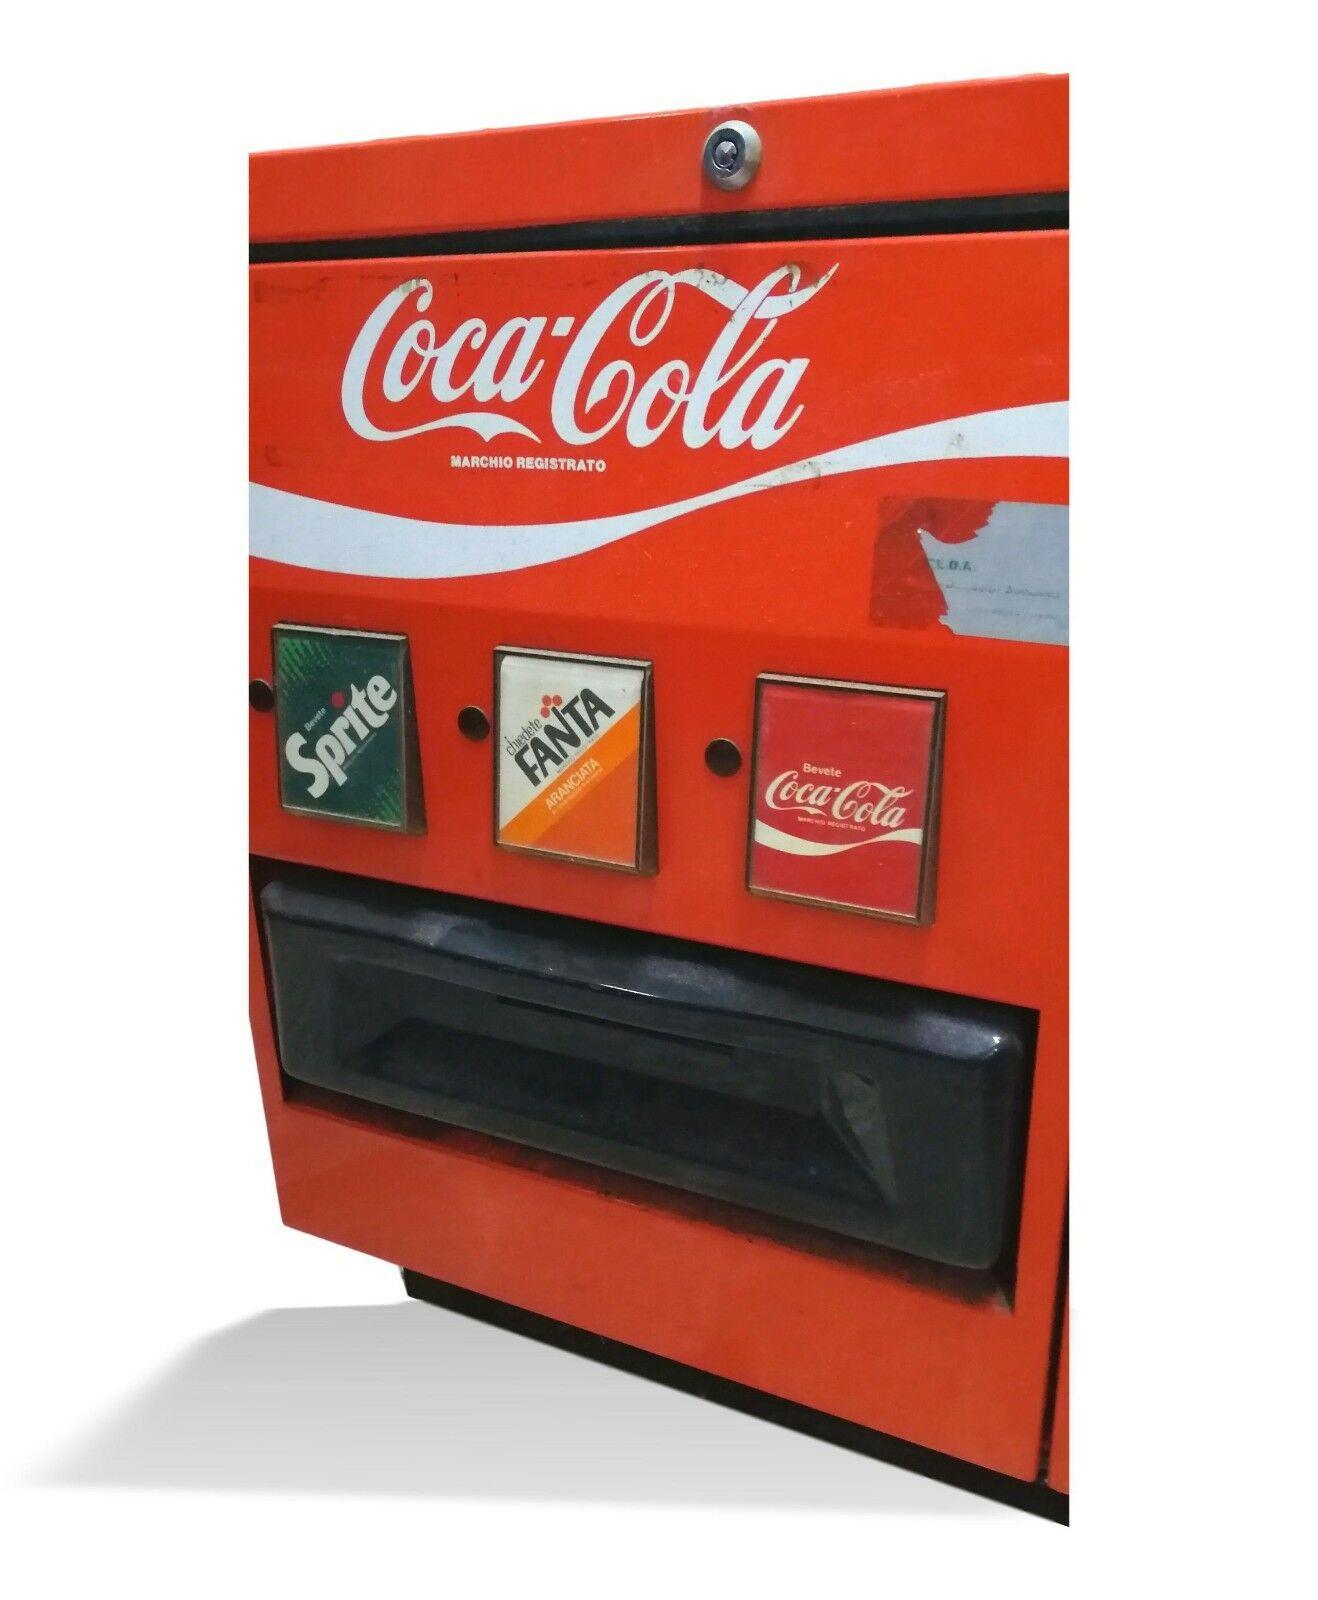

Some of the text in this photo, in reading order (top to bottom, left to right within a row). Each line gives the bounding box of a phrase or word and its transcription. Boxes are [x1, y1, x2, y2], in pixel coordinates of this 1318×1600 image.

[340, 262, 839, 450] Coca-Cola
[450, 455, 607, 472] MARCHIO REGISTRATO
[285, 675, 398, 799] Sprite
[514, 687, 616, 788] FANTA
[545, 757, 601, 811] ARANCIATA
[765, 770, 914, 829] Coca-Cola
[803, 762, 842, 778] Bevete
